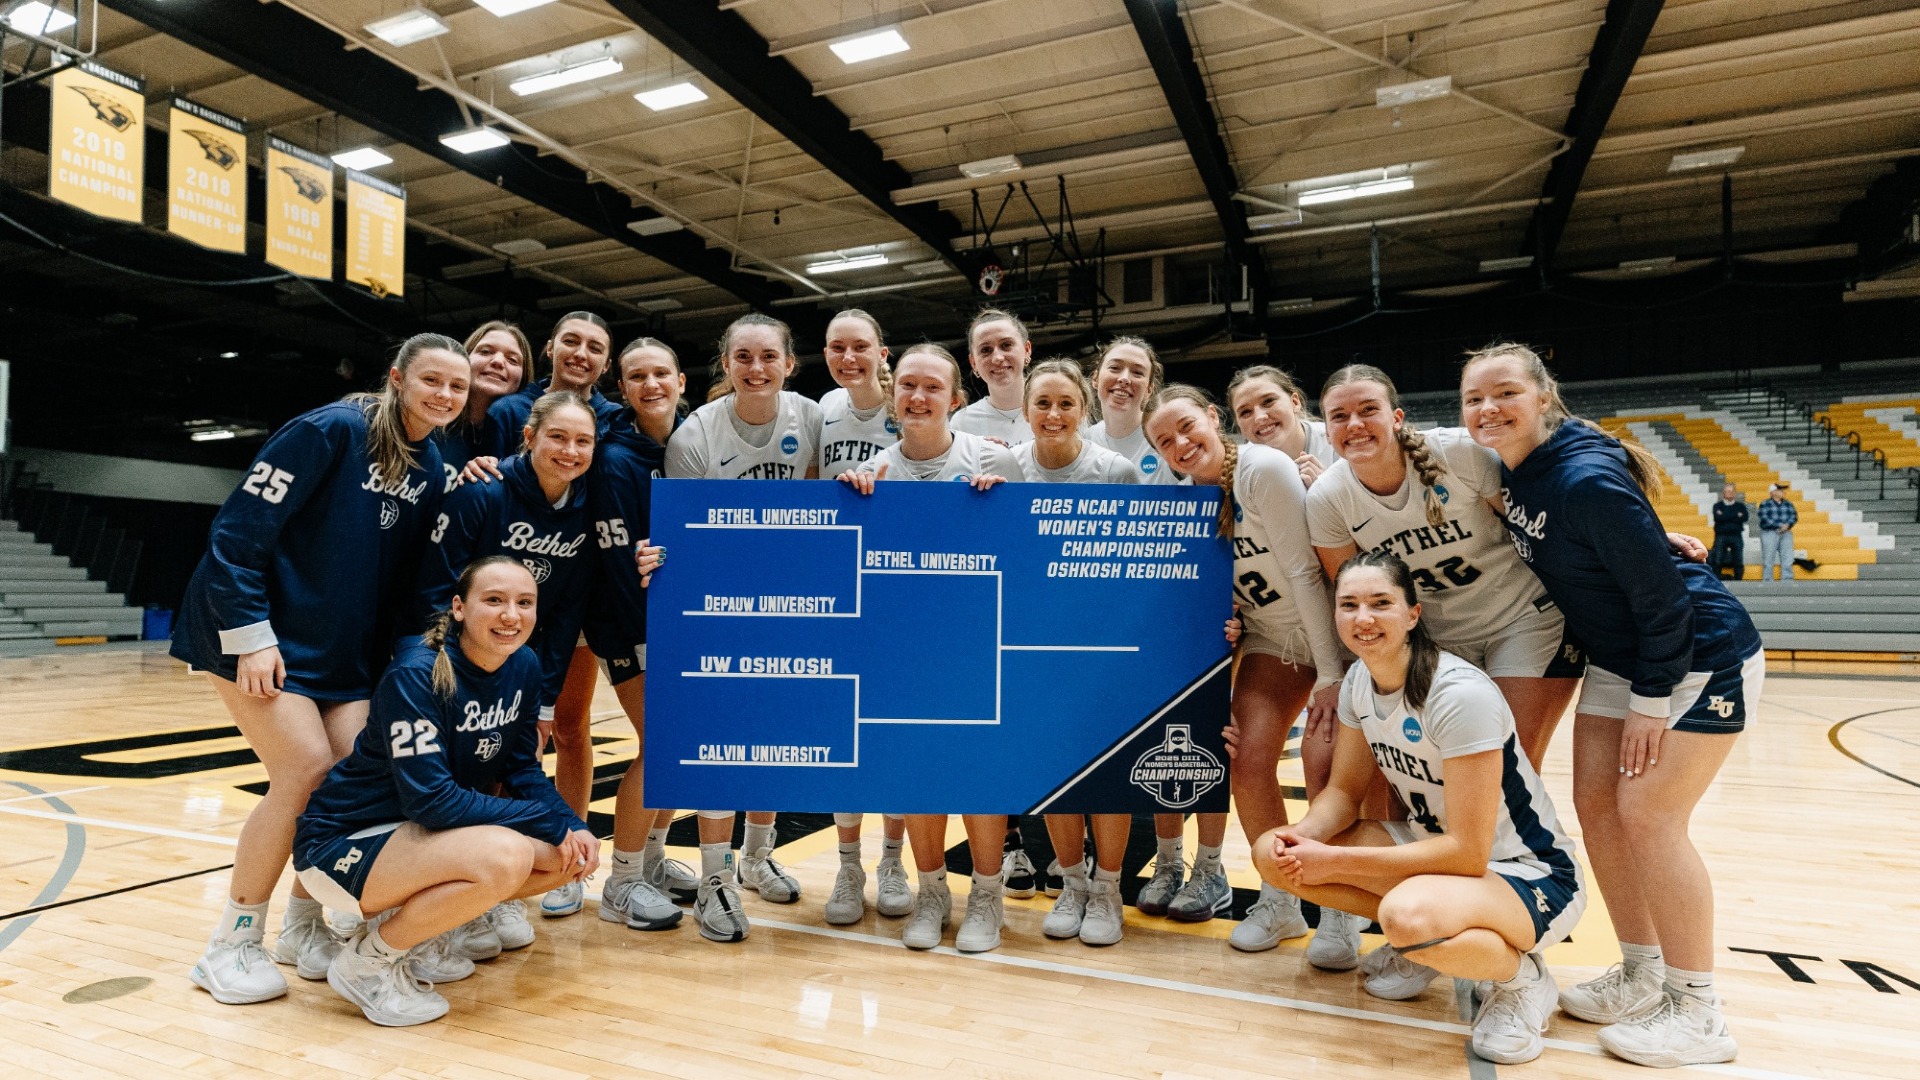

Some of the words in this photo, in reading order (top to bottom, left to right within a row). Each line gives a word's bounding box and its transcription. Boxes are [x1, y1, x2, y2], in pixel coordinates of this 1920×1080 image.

[88, 62, 140, 91] BASKETBALL
[199, 106, 242, 132] BASKETBALL
[72, 126, 126, 161] 2019
[61, 147, 134, 184] NATIONAL
[58, 167, 136, 203] CHAMPION
[185, 166, 231, 197] 2018
[176, 186, 238, 218] NATIONAL
[171, 203, 243, 235] RUNNER-UP
[271, 237, 298, 255] THIRD
[300, 247, 328, 264] PLACE
[824, 440, 885, 468] BETH
[242, 460, 295, 504] 25
[707, 508, 757, 524] BETHEL
[762, 508, 839, 525] UNIVERSITY
[1030, 498, 1074, 515] 2025
[1128, 500, 1197, 517] DIVISION
[1201, 501, 1219, 517] III
[501, 521, 587, 558] Bethel
[595, 518, 630, 549] 35
[1038, 519, 1112, 537] WOMEN'S
[1116, 520, 1211, 539] BASKETBALL
[1371, 519, 1473, 560] ETHEL
[865, 550, 916, 568] BETHEL
[920, 552, 997, 571] UNIVERSITY
[1061, 540, 1188, 558] CHAMPIONSHIP-
[1046, 561, 1122, 579] OSHKOSH
[1125, 563, 1200, 580] REGIONAL
[759, 595, 836, 613] UNIVERSITY
[700, 655, 732, 673] UW
[739, 656, 833, 675] OSHKOSH
[456, 689, 522, 732] Bethel
[1707, 695, 1735, 718] BU
[390, 718, 441, 758] 22
[474, 738, 500, 759] BU
[698, 744, 746, 761] CALVIN
[751, 745, 831, 763] UNIVERSITY
[1371, 742, 1445, 787] ETHEL
[1134, 768, 1221, 781] CHAMPIONSHIP
[333, 846, 363, 874] BU
